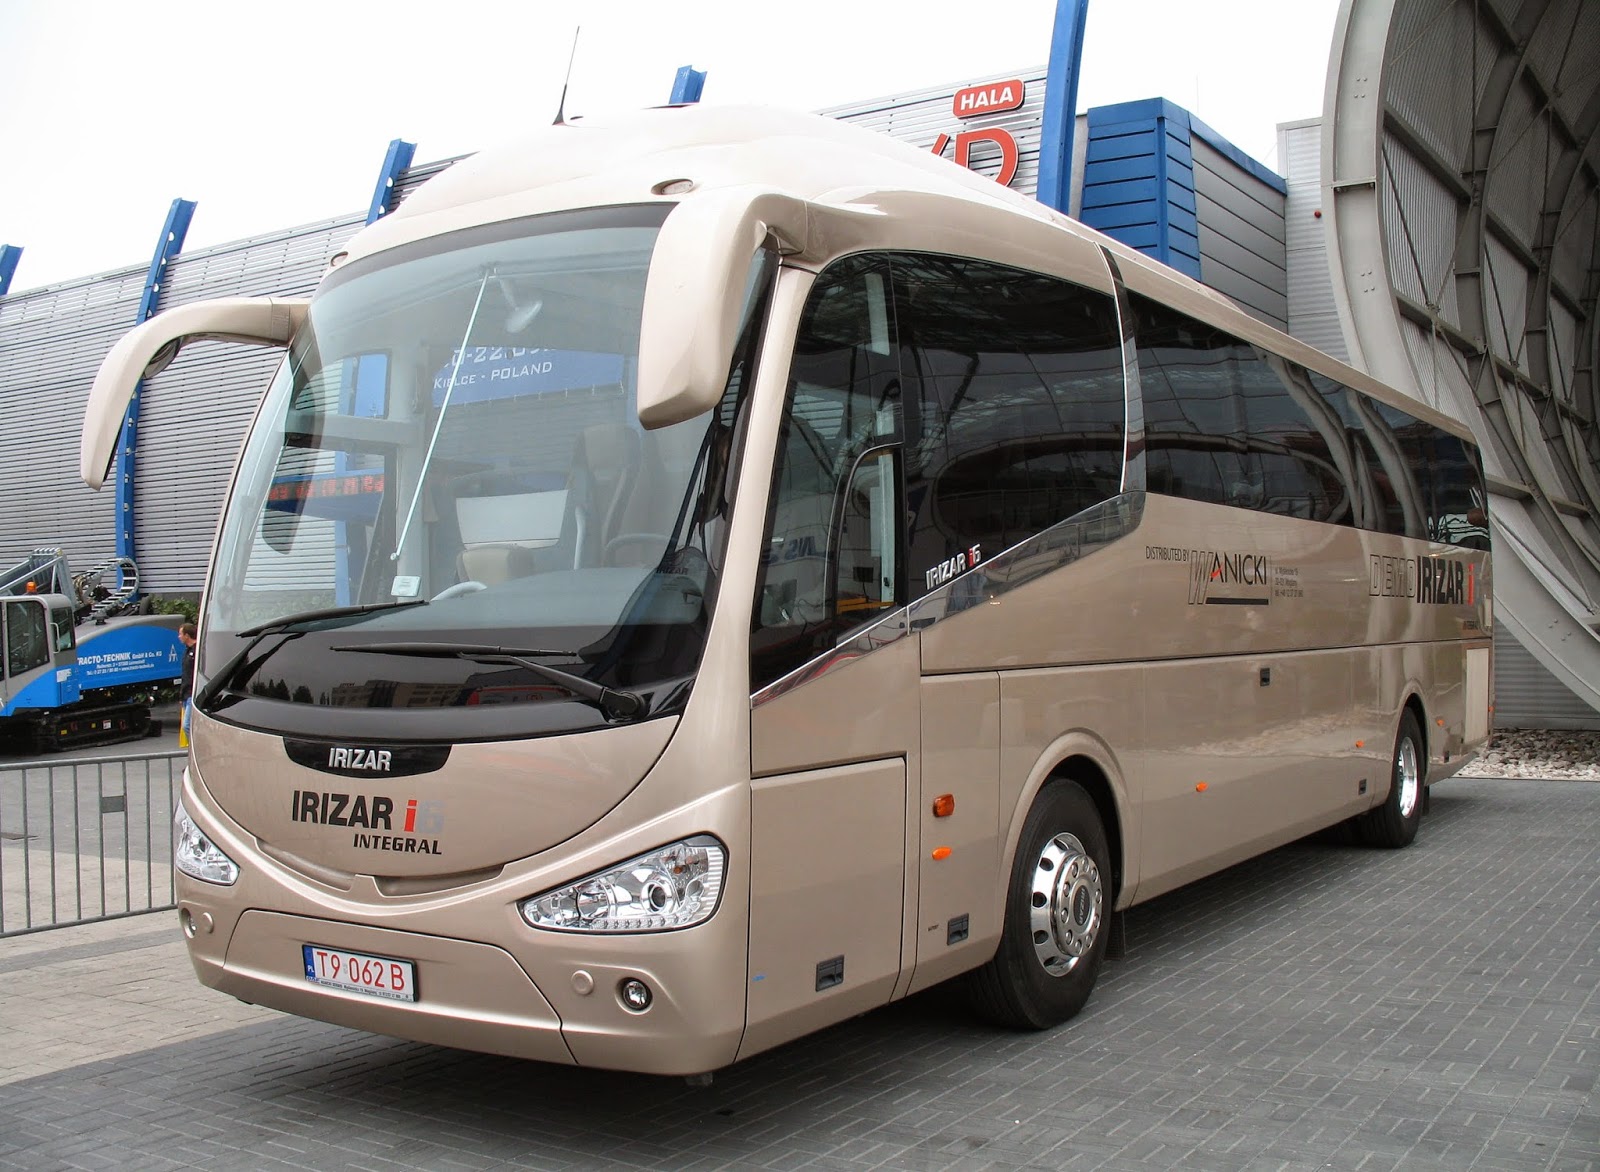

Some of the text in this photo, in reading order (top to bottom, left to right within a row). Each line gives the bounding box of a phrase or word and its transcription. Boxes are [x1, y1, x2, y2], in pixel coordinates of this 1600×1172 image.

[960, 86, 1014, 111] HALA
[433, 361, 553, 390] KIELCE POLAND
[1145, 545, 1182, 562] DISTRIBUTED
[925, 552, 967, 590] IRIZAR
[1416, 554, 1464, 605] IRIZAR
[328, 747, 392, 772] IRIZAR
[292, 789, 394, 831] IRIZAR
[353, 833, 443, 855] INTEGRAL
[316, 951, 341, 979] T9
[348, 957, 405, 991] 062B
